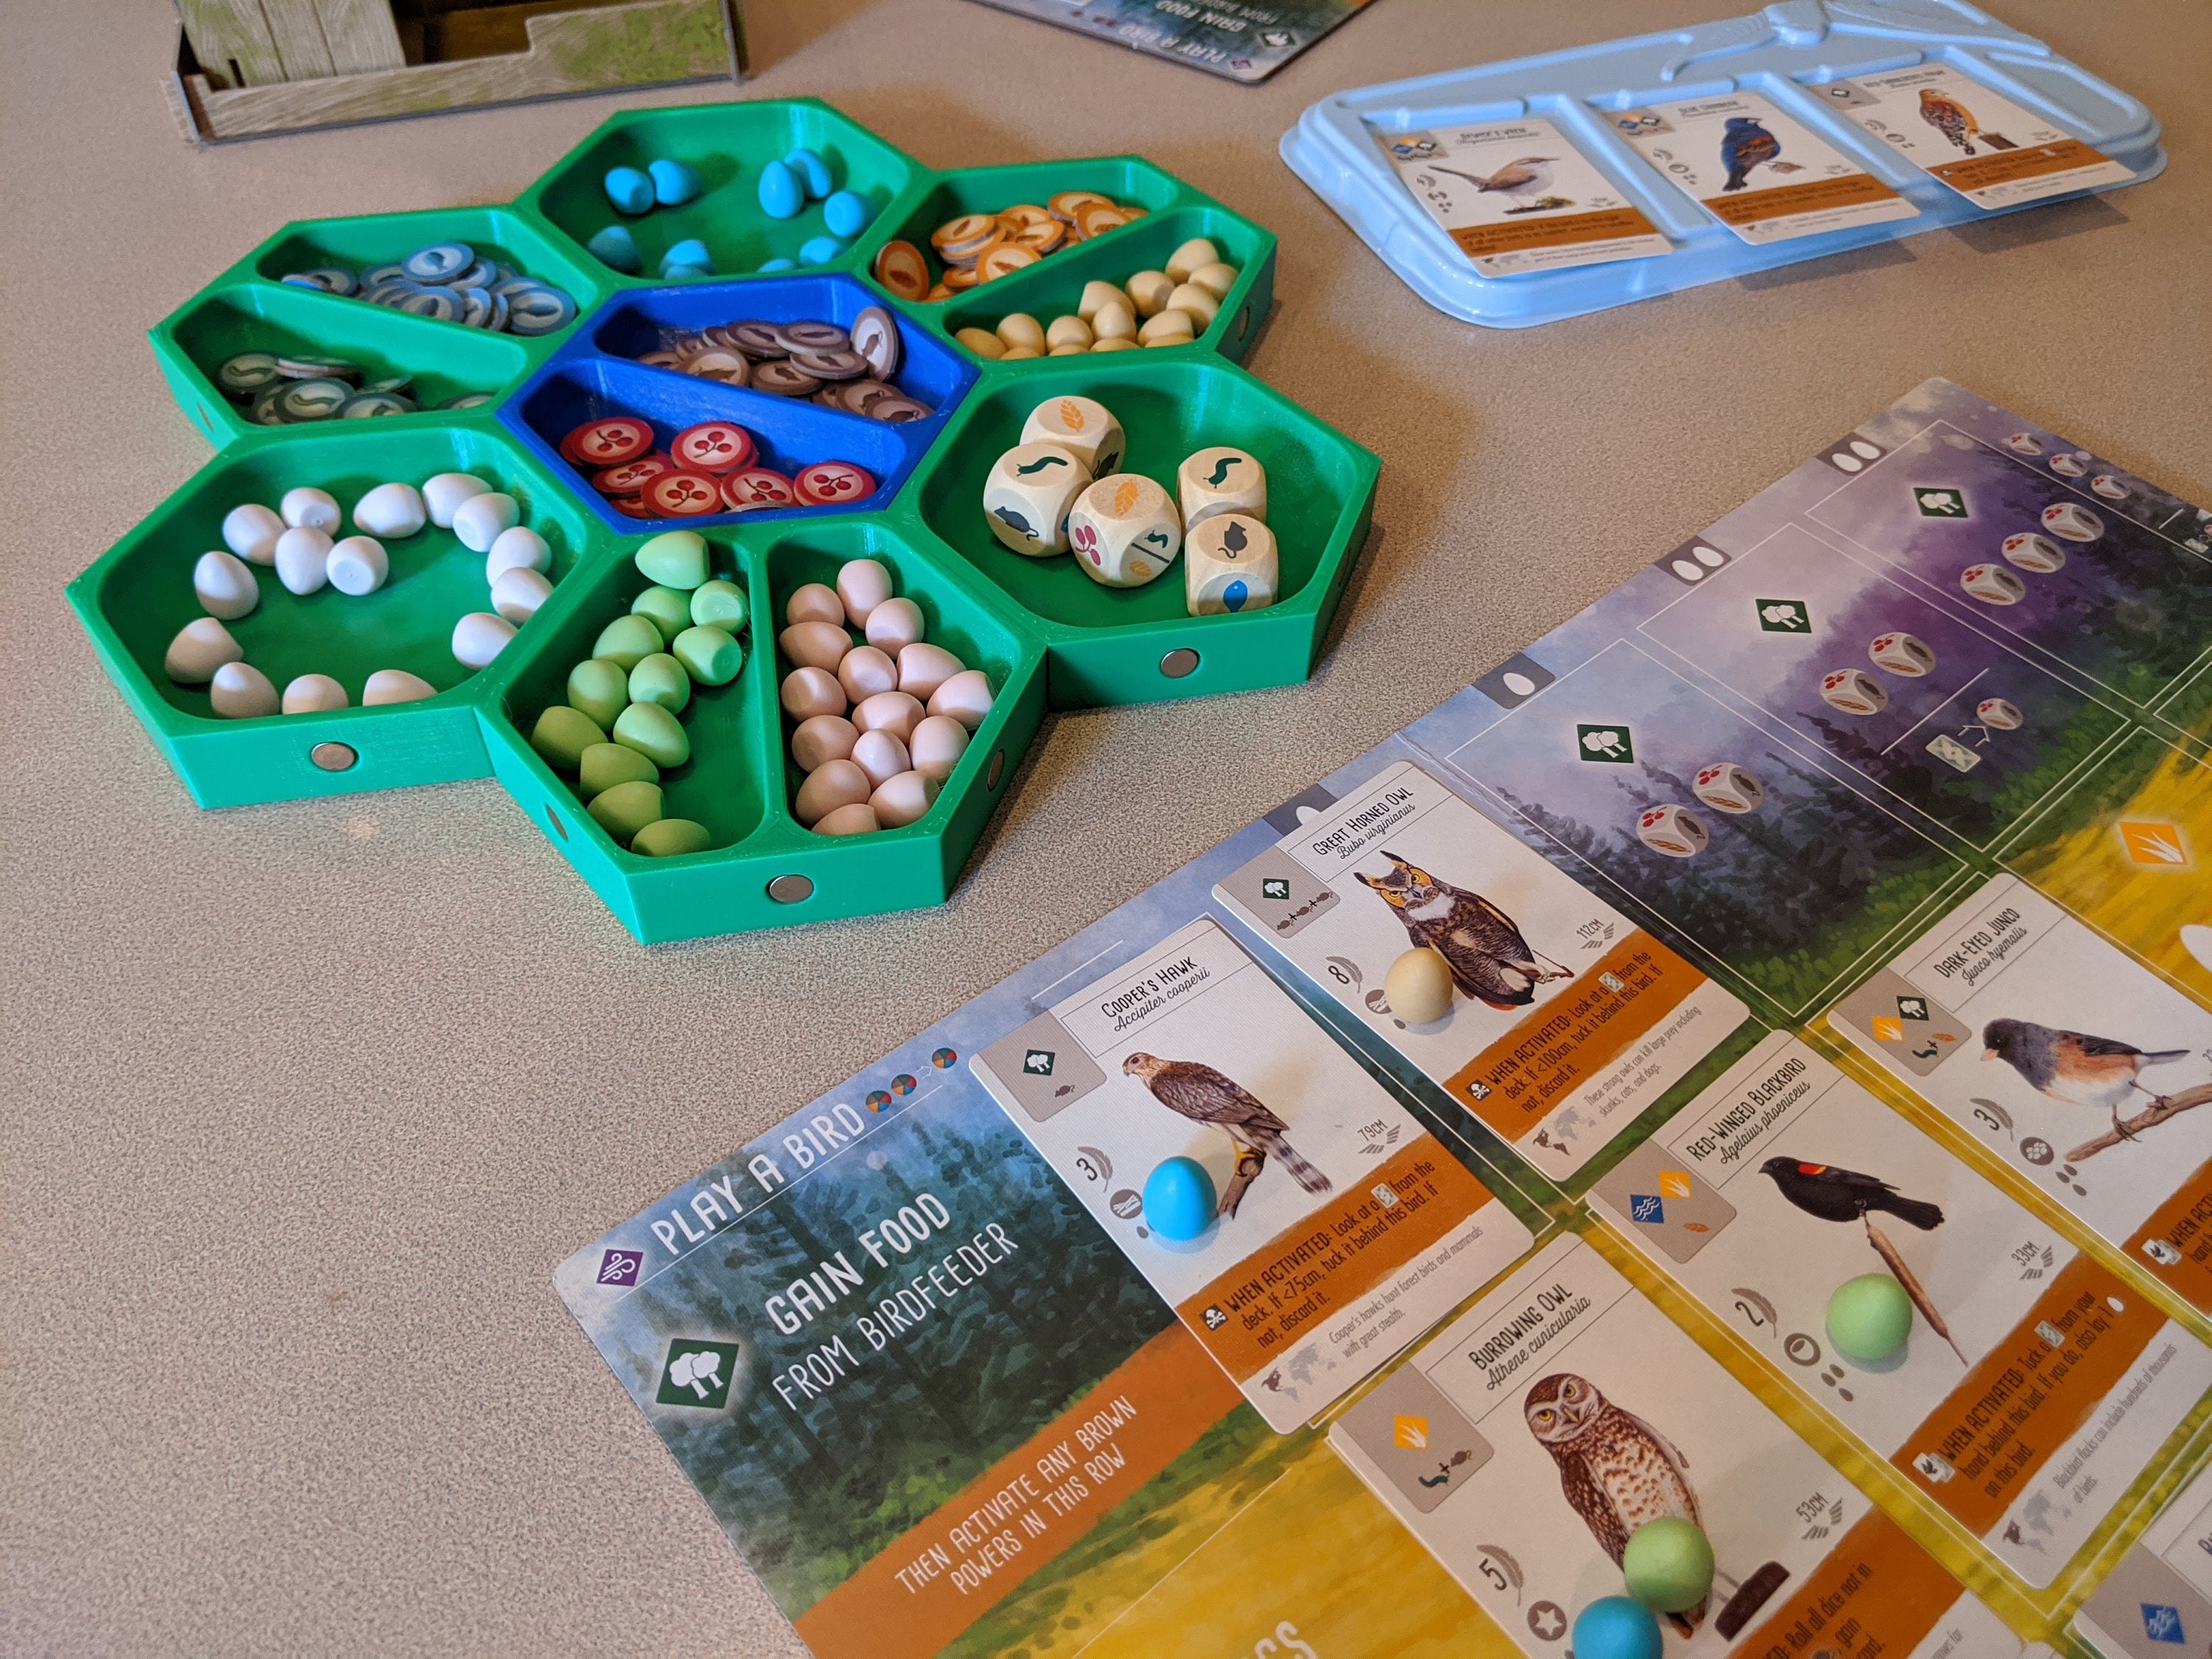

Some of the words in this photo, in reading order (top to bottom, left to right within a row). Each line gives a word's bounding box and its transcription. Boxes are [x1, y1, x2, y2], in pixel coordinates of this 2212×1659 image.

[1160, 38, 1179, 48] A
[1178, 43, 1227, 63] PLAY
[1312, 828, 1350, 855] GREAT
[1346, 802, 1390, 832] HORNED
[1385, 787, 1414, 805] OWL
[1337, 837, 1366, 859] Bubo
[1365, 804, 1416, 841] virginianus
[1576, 919, 1604, 939] 112CM
[1933, 931, 1992, 978] DARK-EYED
[1986, 908, 2020, 936] JUNCO
[1649, 963, 1663, 977] If
[1961, 957, 1991, 987] Junco
[1986, 927, 2028, 961] hyemalis
[1101, 979, 1159, 1018] COOPER'S
[1155, 956, 1198, 984] HAWK
[1328, 964, 1349, 985] 8
[1631, 971, 1658, 990] bird.
[1114, 995, 1166, 1032] Accipiter
[1166, 967, 1210, 999] cooperii
[1591, 996, 1625, 1024] behind
[1618, 987, 1640, 1002] this
[1484, 1057, 1520, 1085] WHEN
[1514, 1015, 1571, 1063] ACTIVATED:
[1568, 998, 1594, 1018] Look
[1590, 990, 1603, 1003] at
[1599, 986, 1610, 995] a
[1613, 961, 1639, 980] from
[1632, 951, 1652, 965] the
[1570, 1024, 1593, 1044] tuck
[1585, 1017, 1600, 1030] it
[1523, 1066, 1539, 1080] If
[1537, 1042, 1577, 1072] <100cm,
[1503, 1077, 1531, 1099] deck.
[1522, 1095, 1545, 1113] not,
[1536, 1067, 1571, 1098] discard
[1562, 1062, 1581, 1076] it.
[1584, 1088, 1605, 1106] These
[1686, 1102, 1756, 1161] RED-WINGED
[1747, 1057, 1806, 1107] BLACKBIRD
[1720, 1123, 1764, 1164] Agelaius
[1761, 1080, 1811, 1130] phoeniceus
[1973, 1108, 2000, 1131] 3
[1357, 1119, 1388, 1141] 79CM
[651, 1175, 743, 1256] PLAY
[748, 1152, 785, 1193] A
[784, 1102, 866, 1169] BIRD
[1076, 1158, 1098, 1181] 3
[1223, 1279, 1265, 1312] WHEN
[1261, 1232, 1332, 1287] ACTIVATED:
[1329, 1212, 1361, 1237] Look
[1357, 1204, 1372, 1219] at
[1369, 1200, 1380, 1211] a
[1389, 1173, 1419, 1194] from
[1413, 1161, 1435, 1178] the
[2164, 1217, 2200, 1248] WHEN
[765, 1251, 863, 1334] GAIN
[858, 1192, 951, 1268] FOOD
[1241, 1304, 1274, 1331] deck.
[1267, 1292, 1283, 1310] If
[1284, 1270, 1326, 1299] <75cm,
[1320, 1249, 1347, 1272] tuck
[1340, 1242, 1355, 1256] it
[1349, 1217, 1389, 1250] behind
[1383, 1207, 1408, 1226] this
[1400, 1189, 1430, 1212] bird.
[1423, 1180, 1439, 1196] If
[2011, 1241, 2039, 1267] 33CM
[771, 1335, 860, 1411] FROM
[856, 1222, 1019, 1351] BIRDFEEDER
[1257, 1327, 1284, 1349] not,
[1279, 1295, 1318, 1332] discard
[1312, 1290, 1331, 1306] it.
[1360, 1299, 1385, 1321] hawks
[1734, 1300, 1764, 1328] 2
[1468, 1306, 1544, 1371] BURROWING
[1537, 1283, 1573, 1312] OWL
[1486, 1349, 1530, 1391] Athene
[1528, 1296, 1591, 1354] cunicularia
[1936, 1425, 1976, 1461] WHEN
[1965, 1368, 2025, 1432] ACTIVATED:
[2017, 1347, 2045, 1371] Tuck
[2039, 1342, 2051, 1353] a
[894, 1543, 951, 1594] THEN
[949, 1474, 1040, 1554] ACTIVATE
[1037, 1441, 1077, 1484] ANY
[1075, 1395, 1138, 1452] BROWN
[1795, 1492, 1829, 1523] 53CM
[950, 1529, 1023, 1596] POWERS
[1020, 1509, 1047, 1539] IN
[1043, 1475, 1089, 1517] THIS
[1083, 1442, 1127, 1485] ROW
[1479, 1559, 1509, 1592] 5
